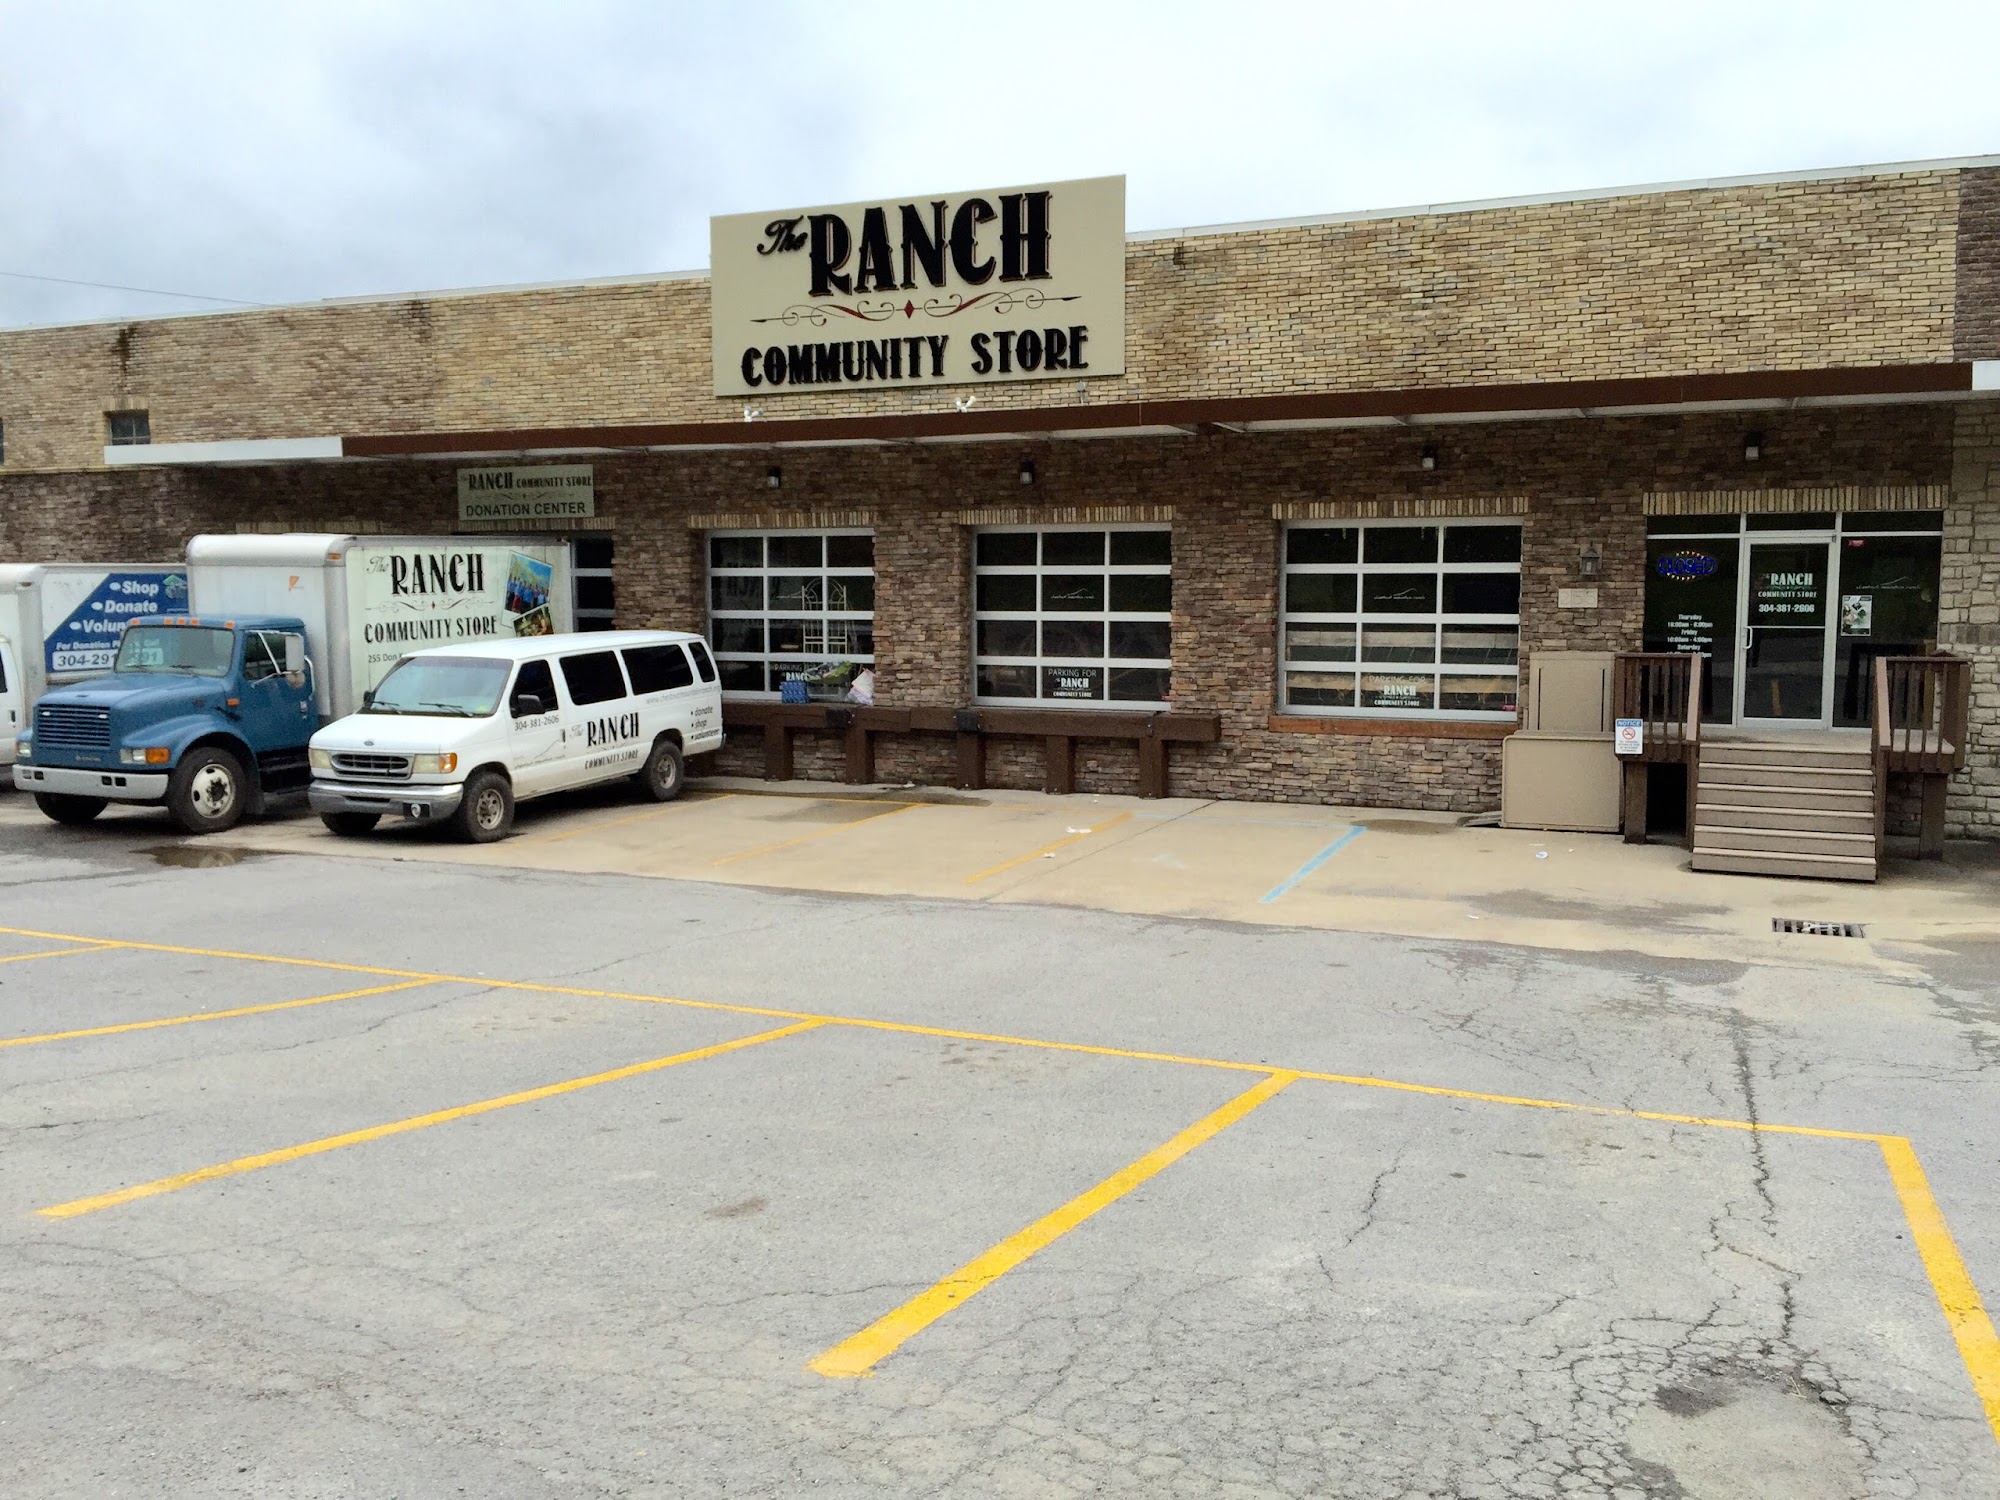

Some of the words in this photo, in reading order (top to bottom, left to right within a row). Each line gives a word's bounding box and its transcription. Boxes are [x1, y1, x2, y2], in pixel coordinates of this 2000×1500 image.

[757, 214, 808, 254] The
[808, 190, 1053, 298] RANCH
[741, 334, 949, 387] COMMUNITY
[970, 325, 1089, 375] STORE
[468, 472, 514, 490] RANCH
[516, 476, 564, 488] COMMUNITY
[566, 475, 592, 487] STORE
[466, 503, 530, 516] DONATION
[534, 502, 586, 515] CENTER
[1657, 557, 1715, 575] CLOSED
[366, 555, 389, 574] The
[389, 553, 485, 597] RANCH
[1770, 572, 1814, 586] RANCH
[122, 580, 159, 597] Shop
[104, 600, 158, 613] Donate
[364, 617, 452, 644] COMMUNITY
[457, 615, 498, 637] STORE
[368, 654, 381, 663] 255
[383, 653, 397, 661] Don
[1048, 668, 1080, 677] PARKING
[1082, 669, 1097, 677] FOR
[1061, 677, 1089, 688] RANCH
[1383, 684, 1417, 696] RANCH
[514, 714, 560, 731] 304-381-2606
[586, 712, 640, 747] RANCH
[584, 754, 620, 770] COMMUNITY
[620, 749, 639, 762] STORE
